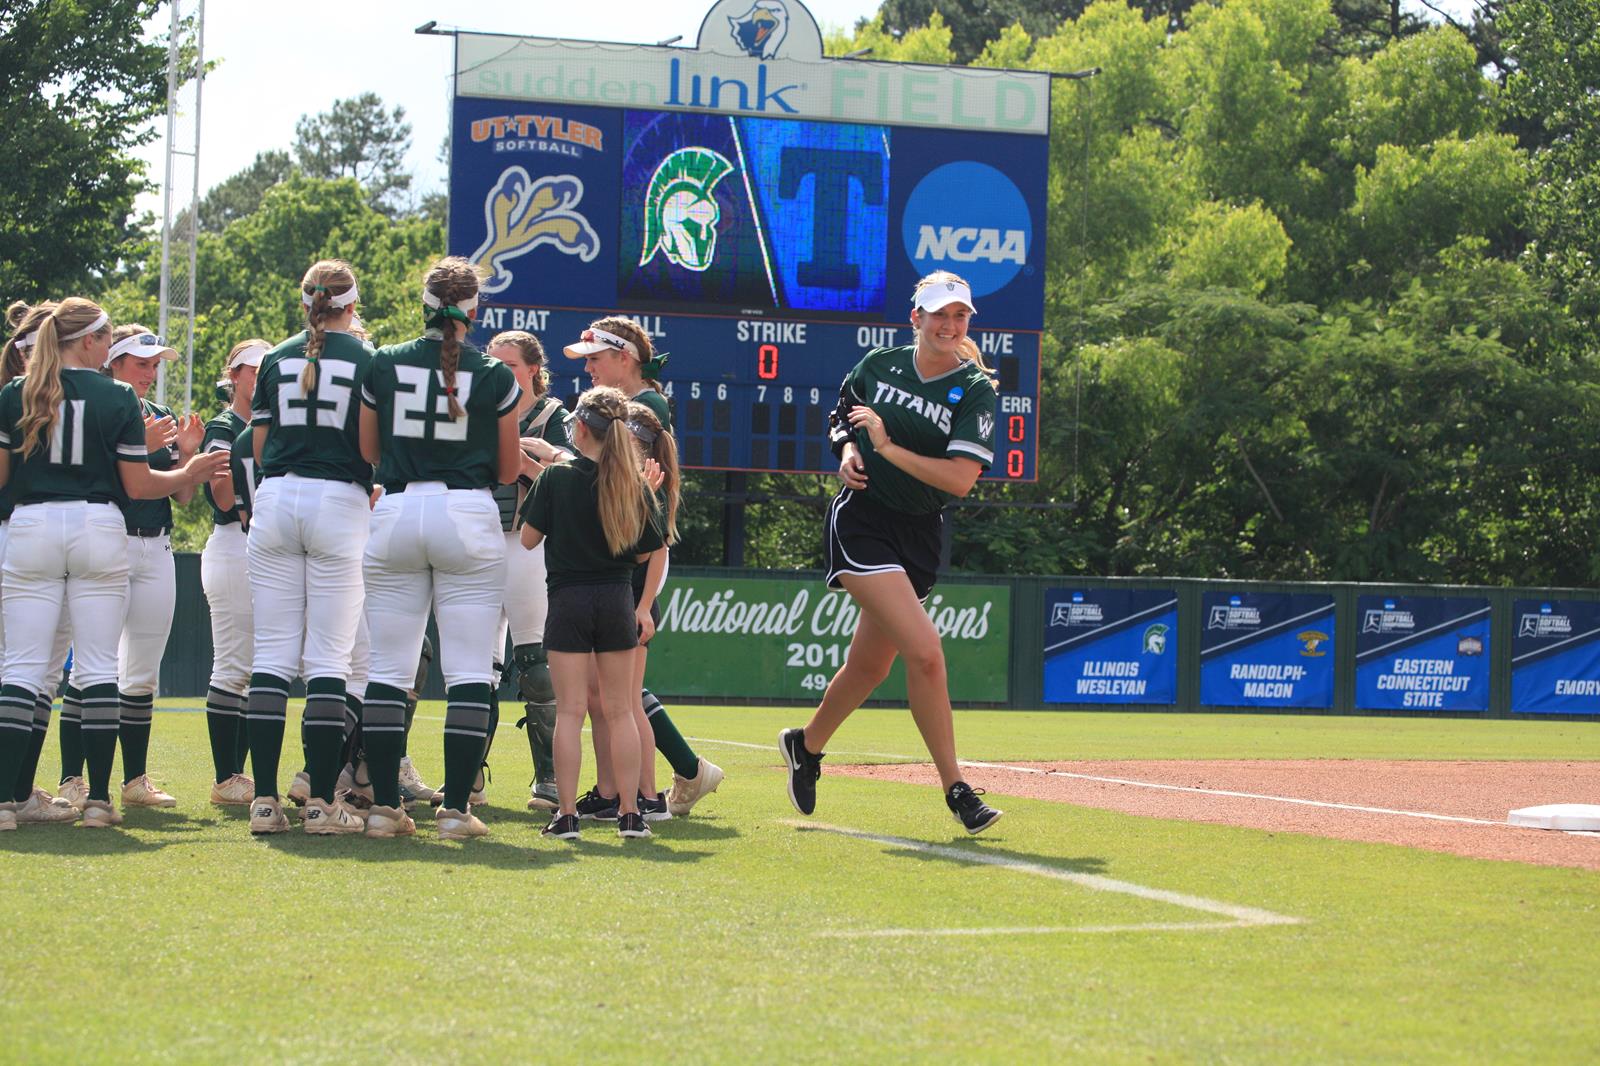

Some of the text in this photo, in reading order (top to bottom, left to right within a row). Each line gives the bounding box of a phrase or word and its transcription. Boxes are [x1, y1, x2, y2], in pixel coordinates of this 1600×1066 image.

[831, 68, 1037, 128] FIELD
[495, 140, 579, 157] SOFTBALL
[914, 225, 1026, 265] NCAA
[482, 308, 507, 329] AT
[513, 309, 550, 332] BAT
[737, 320, 806, 344] STRIKE
[857, 327, 897, 348] OUT
[758, 344, 779, 379] 0
[277, 358, 356, 430] 25
[392, 364, 473, 441] 23
[572, 377, 819, 405] 1 4 5 6 7 8 9
[873, 381, 952, 435] TITANS
[1001, 396, 1032, 413] ERR
[1009, 416, 1025, 441] 0
[1007, 450, 1024, 477] 0
[656, 588, 809, 636] National
[1083, 661, 1140, 677] ILLINOIS
[1230, 664, 1307, 680] RANDOLPH-
[1393, 659, 1454, 675] EASTERN
[1076, 679, 1146, 695] WESLEYAN
[1243, 682, 1293, 698] MACON
[1377, 674, 1471, 691] CONNECTICUT
[1403, 692, 1444, 707] STATE
